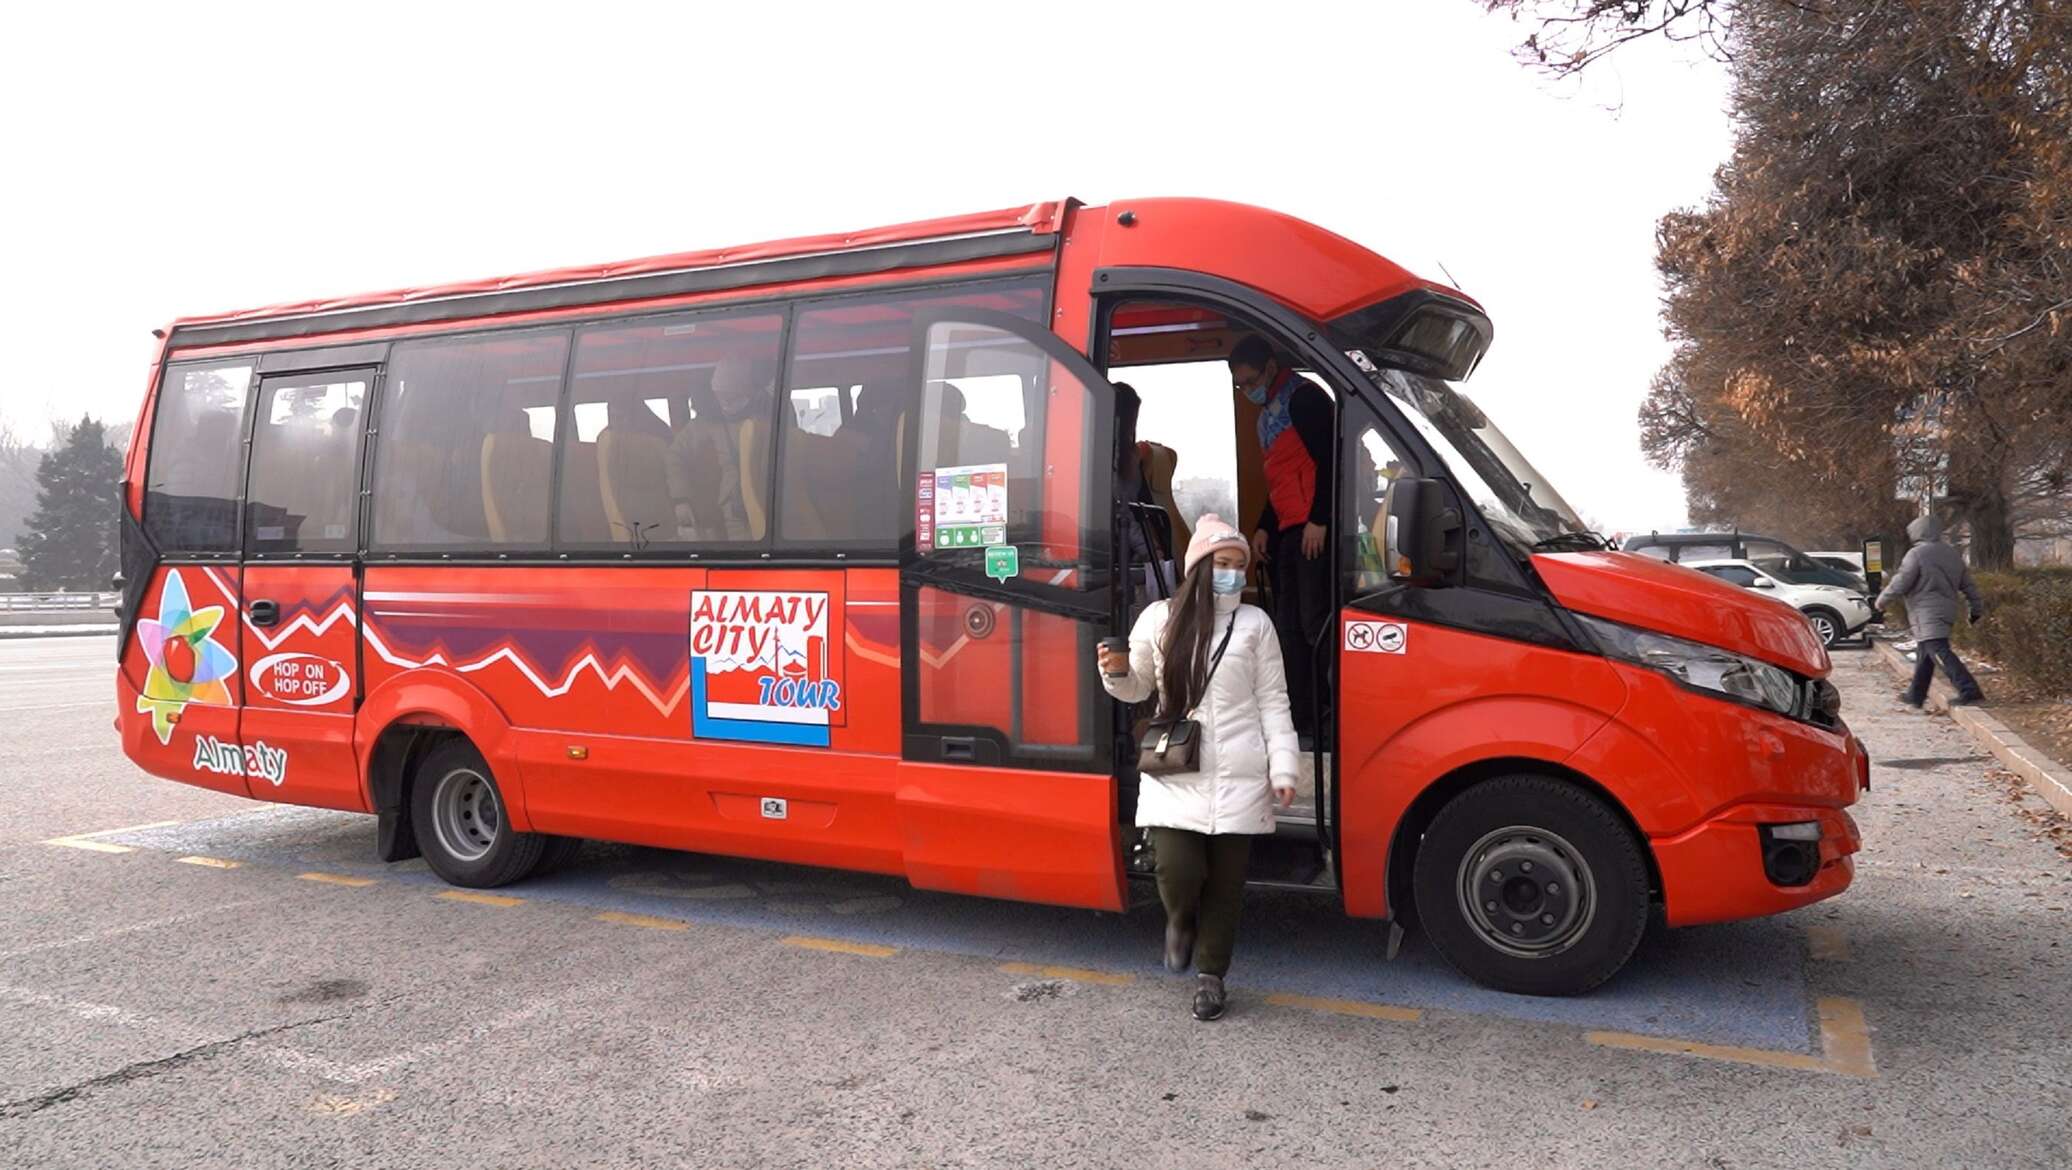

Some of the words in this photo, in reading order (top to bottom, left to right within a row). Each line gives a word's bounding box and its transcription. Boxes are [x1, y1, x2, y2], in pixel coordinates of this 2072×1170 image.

[692, 595, 826, 632] ALMATY
[693, 624, 769, 663] CITY
[273, 663, 300, 678] HOP
[306, 665, 323, 679] ON
[275, 681, 301, 693] HOP
[303, 682, 327, 695] OFF
[759, 677, 842, 711] TOUR
[194, 735, 288, 786] Almaty
